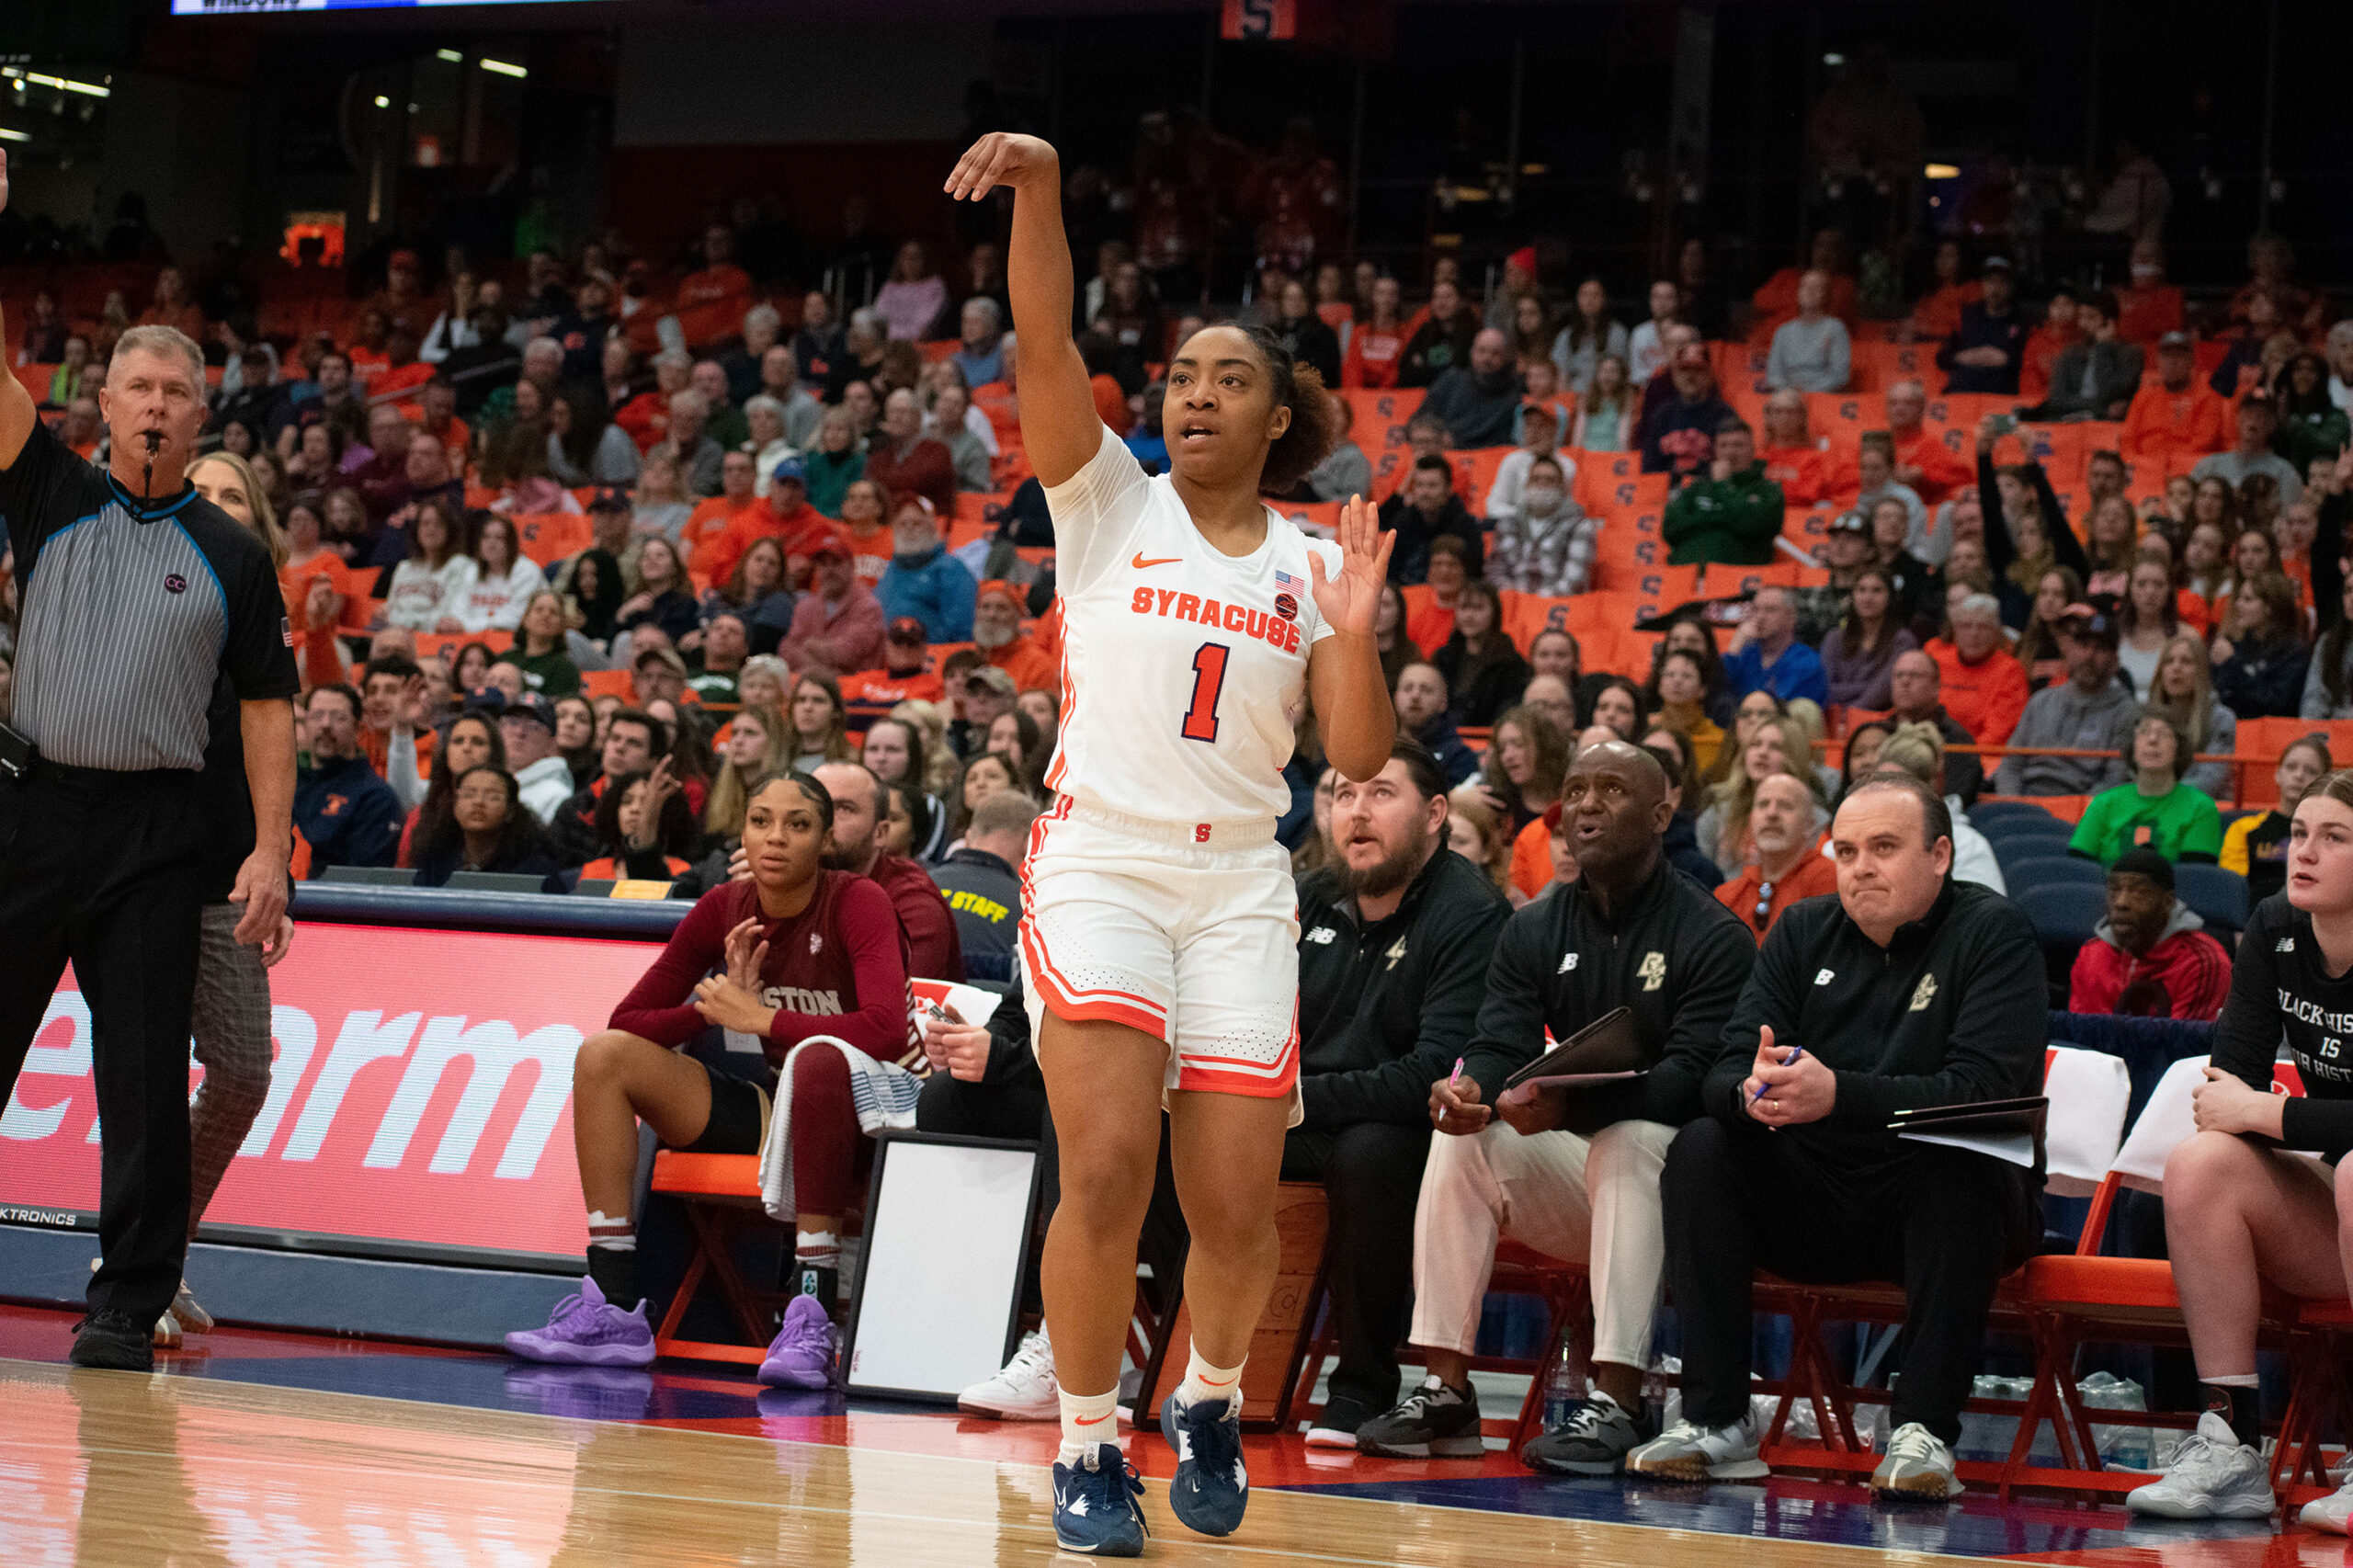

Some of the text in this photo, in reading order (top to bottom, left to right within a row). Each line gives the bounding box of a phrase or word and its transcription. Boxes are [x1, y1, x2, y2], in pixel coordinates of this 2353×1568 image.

[1131, 586, 1301, 654] SYRACUSE
[1181, 642, 1230, 744] 1
[1196, 824, 1211, 842] S
[950, 891, 1009, 923] STAFF
[757, 986, 843, 1016] STON
[2320, 1037, 2341, 1058] IS
